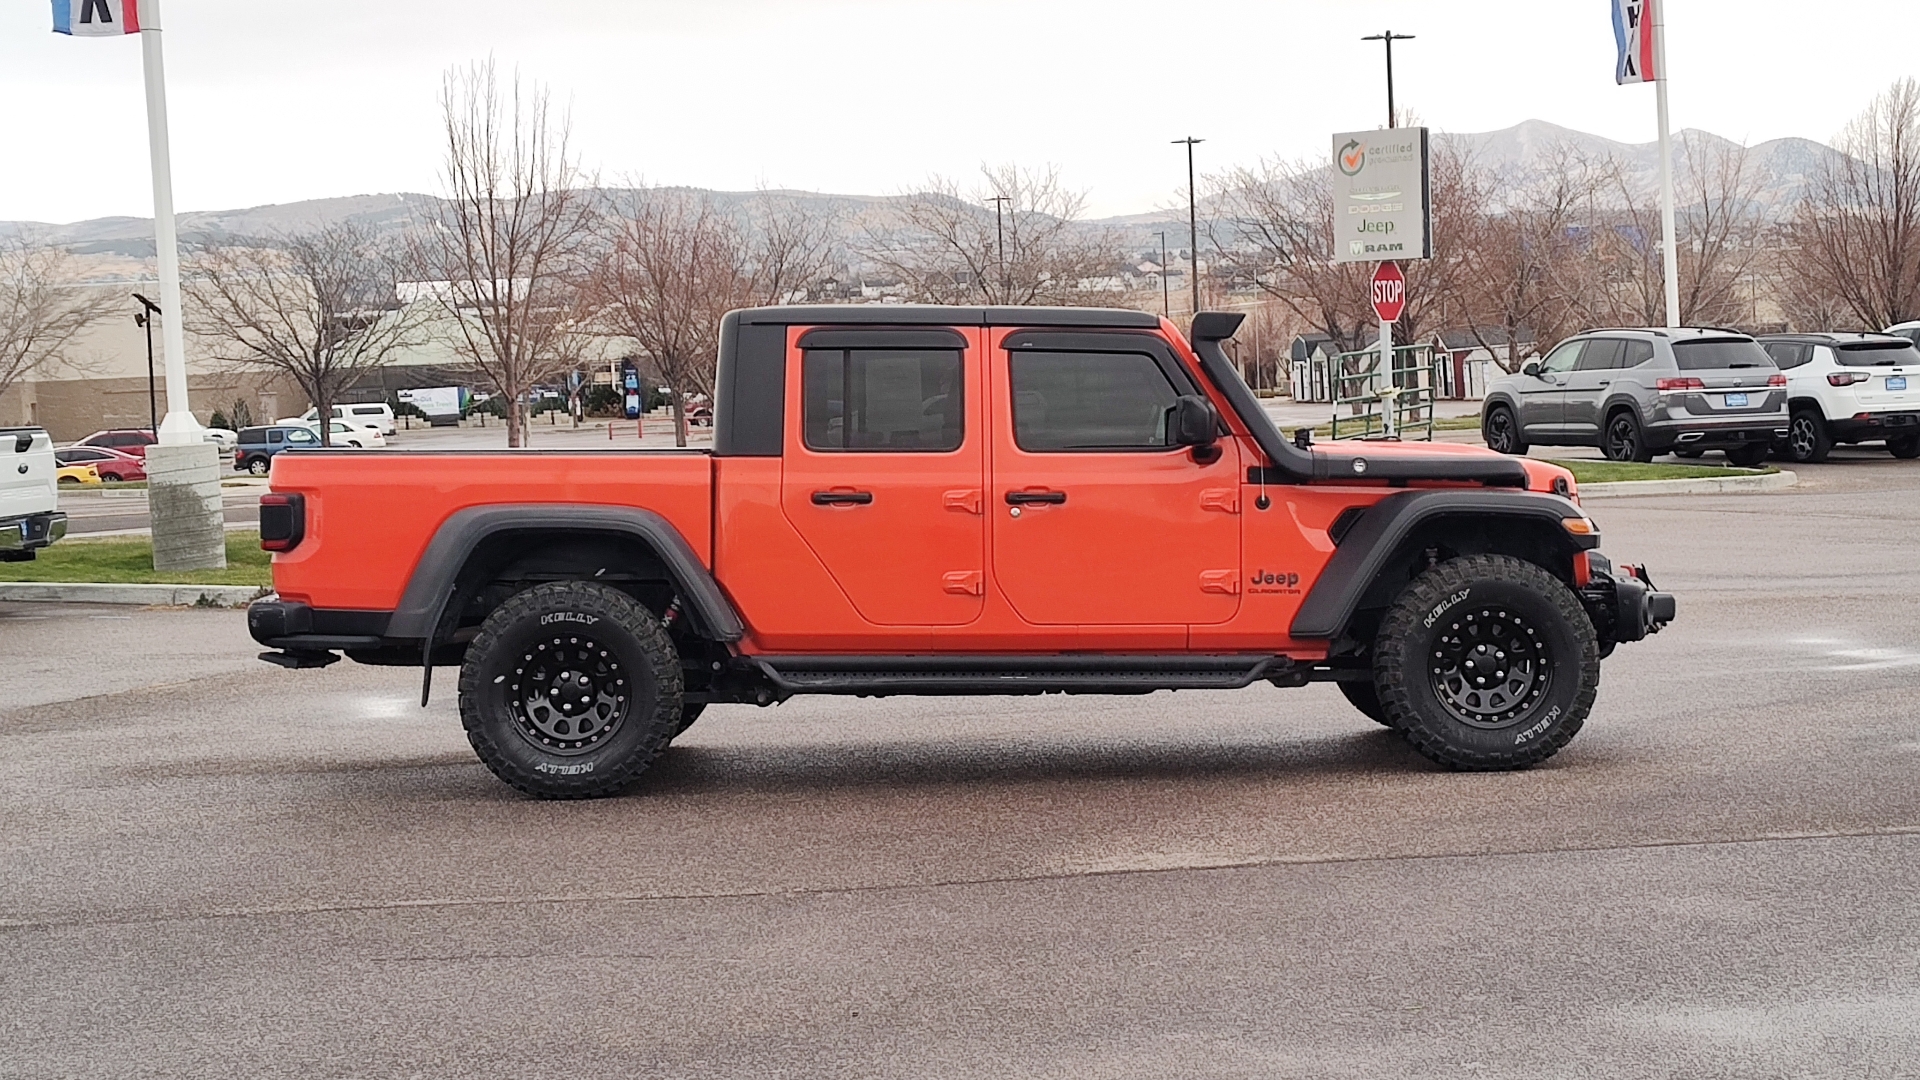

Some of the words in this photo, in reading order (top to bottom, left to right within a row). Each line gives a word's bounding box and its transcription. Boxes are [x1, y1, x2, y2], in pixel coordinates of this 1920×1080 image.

[1369, 142, 1412, 155] certified
[1357, 219, 1394, 234] Jeep
[1365, 243, 1403, 253] RAM
[1374, 280, 1402, 303] STOP
[1250, 569, 1299, 587] Jeep
[1423, 588, 1470, 628] KELLY
[541, 612, 599, 625] KELLY
[1515, 705, 1561, 745] KELLY
[535, 762, 594, 775] KELLY
